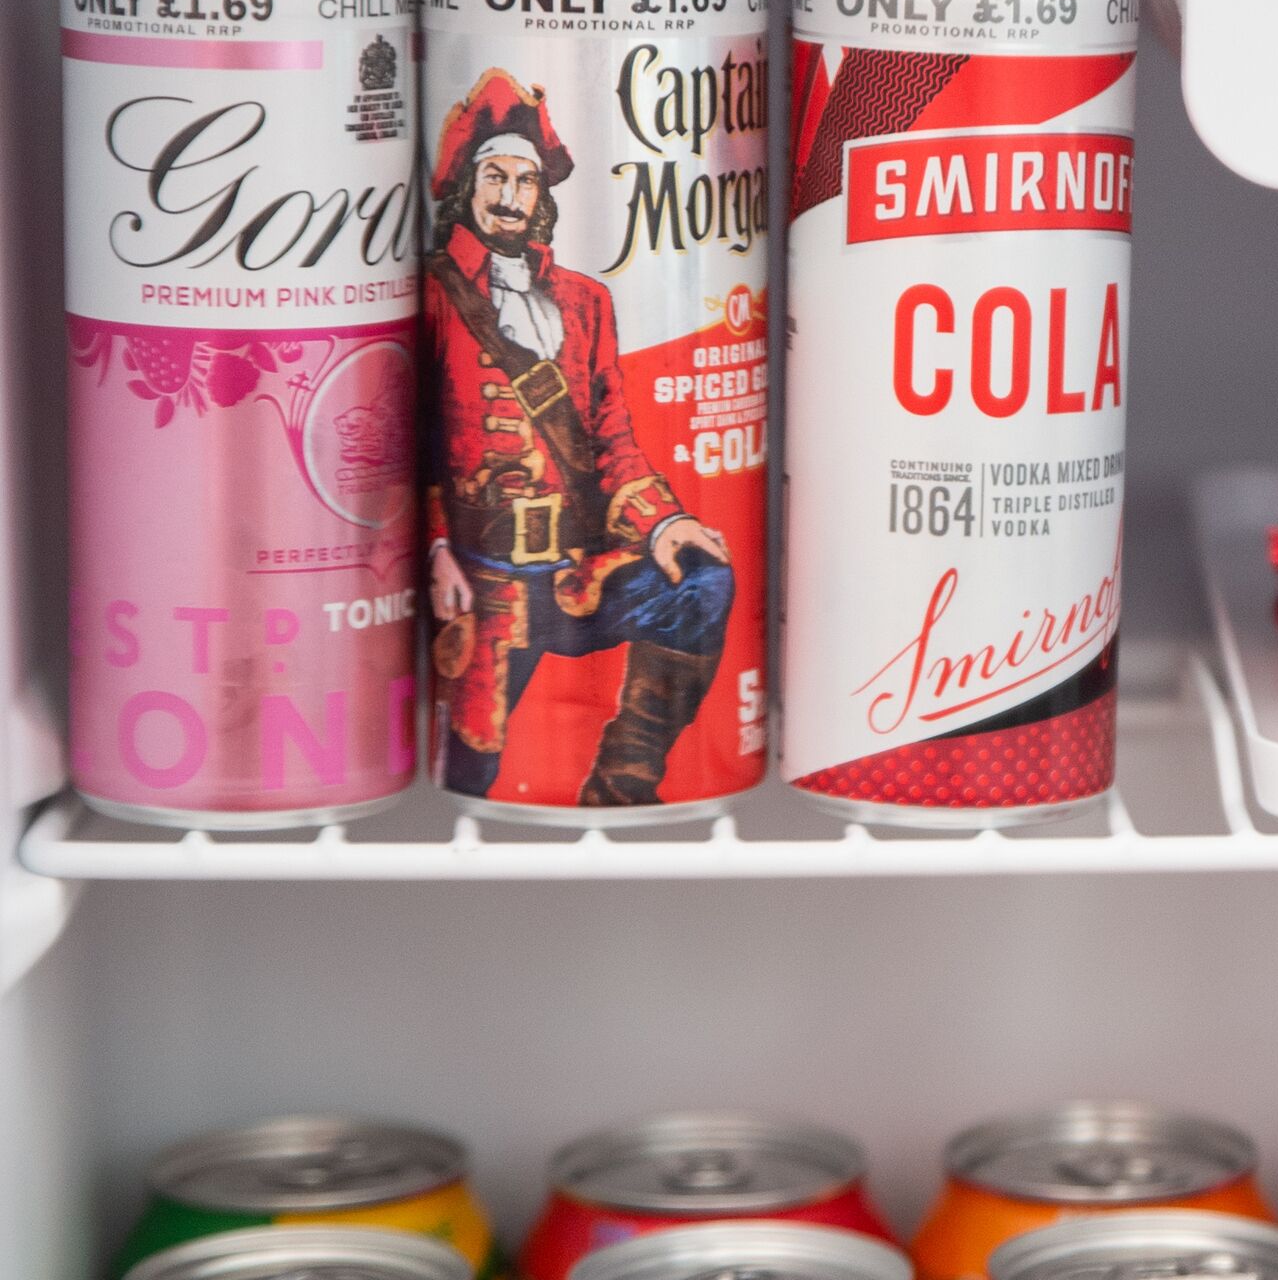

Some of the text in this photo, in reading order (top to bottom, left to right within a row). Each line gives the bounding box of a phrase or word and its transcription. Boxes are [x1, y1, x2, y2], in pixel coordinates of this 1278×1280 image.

[86, 17, 242, 38] PROMOTIONAL RRP
[525, 17, 696, 32] PROMOTIONAL RRP
[870, 21, 1041, 40] PROMOTIONAL RRP
[141, 283, 266, 309] PREMIUM
[276, 285, 337, 308] PINK
[892, 282, 1122, 419] COLA
[654, 368, 749, 404] SPICED
[890, 459, 973, 473] CONTINUING
[990, 462, 1052, 487] VODKA
[1057, 457, 1100, 484] MIXED
[888, 483, 976, 538] 1864
[992, 487, 1115, 515] TRIPLE DISTILLED
[991, 518, 1051, 538] VODKA
